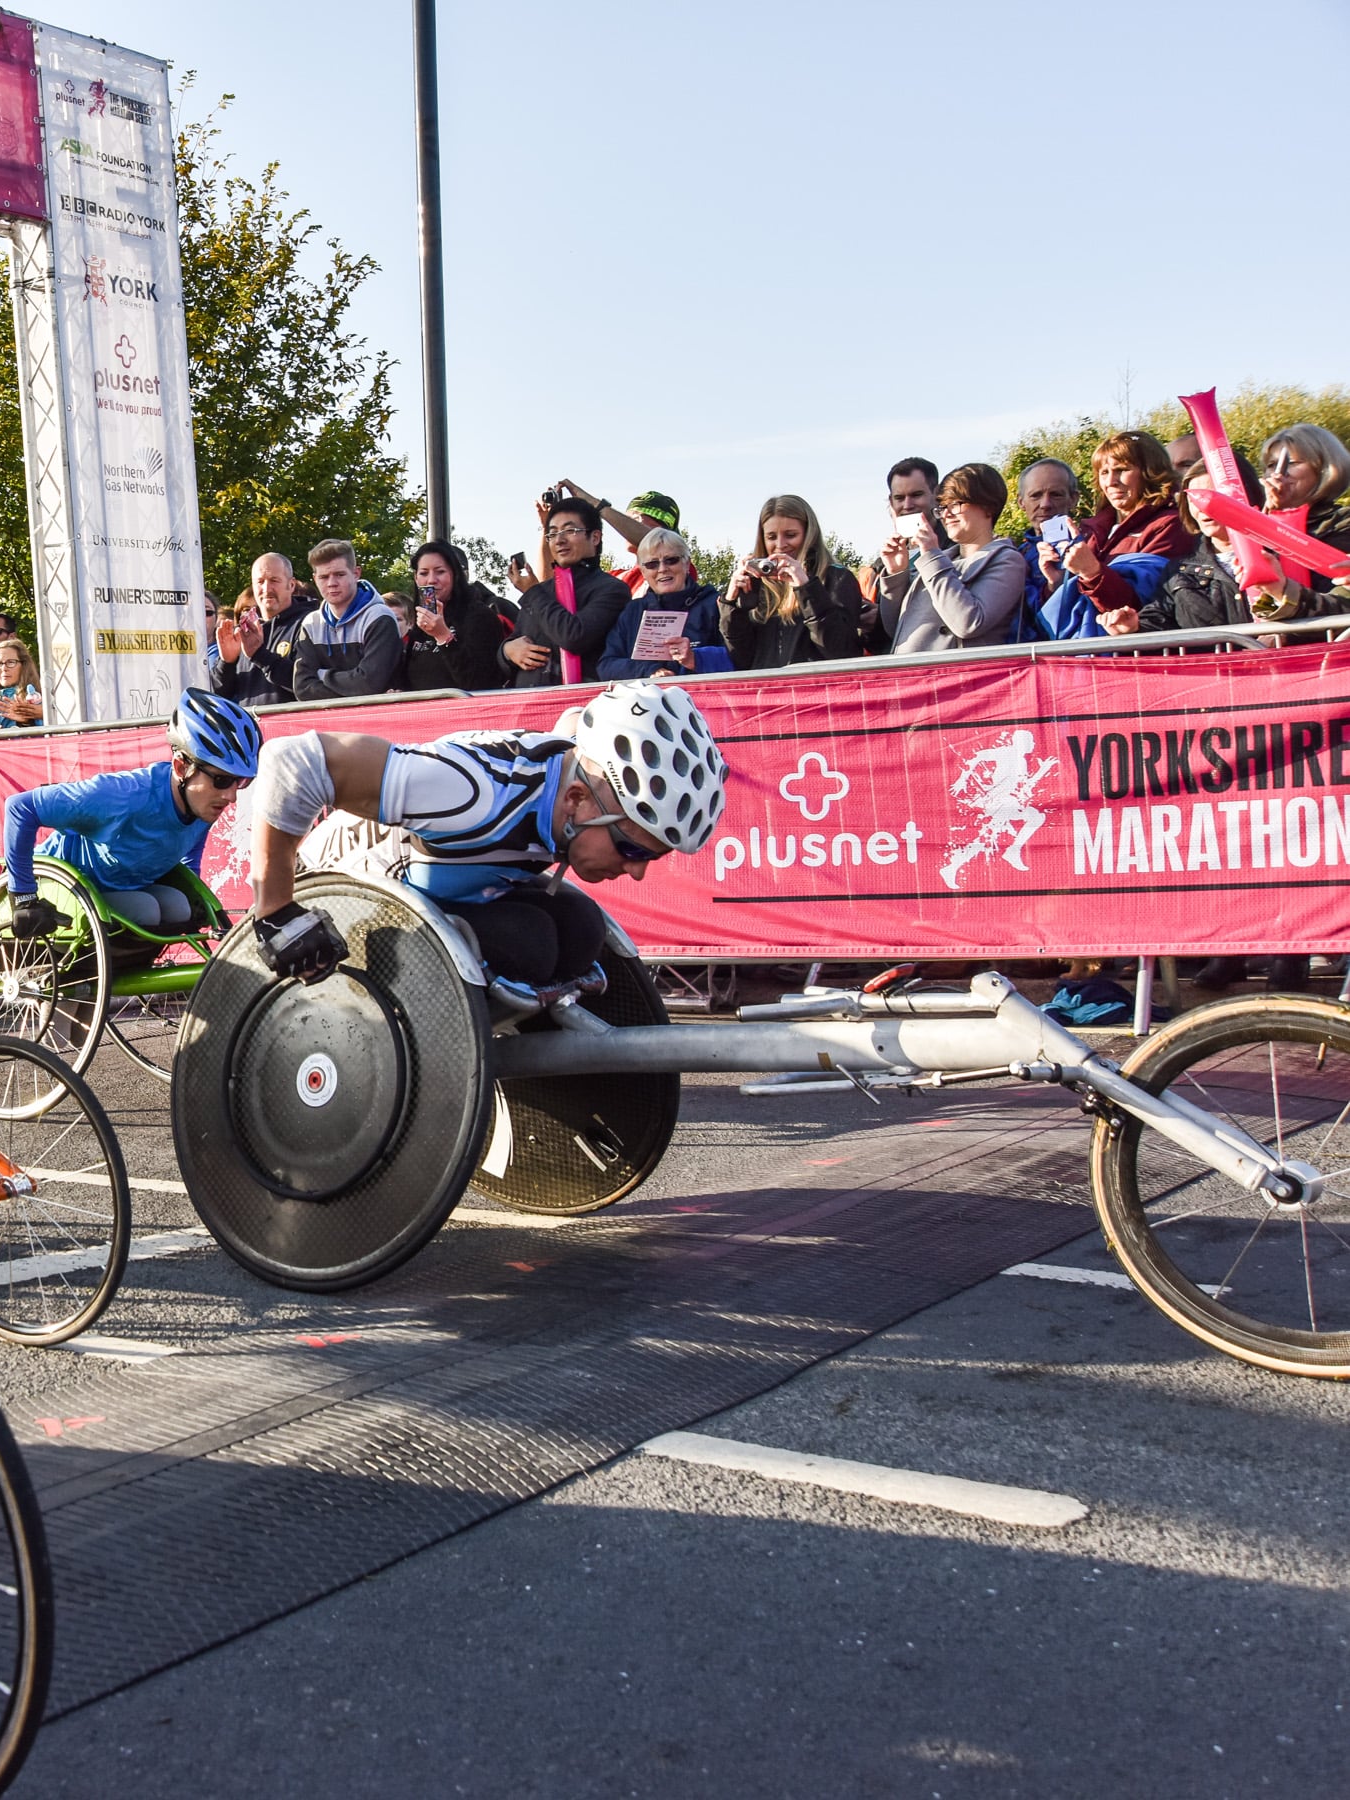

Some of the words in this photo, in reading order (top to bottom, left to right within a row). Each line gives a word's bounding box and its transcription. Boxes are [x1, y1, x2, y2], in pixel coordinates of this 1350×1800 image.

[55, 92, 85, 106] plusnet
[61, 138, 93, 158] ASDA
[97, 152, 151, 174] FOUNDATION
[61, 195, 97, 216] BBC
[99, 206, 135, 224] RADIO
[137, 215, 166, 232] YORK
[107, 273, 159, 302] YORK
[119, 299, 148, 310] COUNCIL
[94, 368, 160, 396] plusnet
[96, 397, 115, 410] We'll
[116, 401, 124, 412] do
[124, 404, 139, 414] you
[141, 406, 161, 416] proud
[104, 464, 145, 479] Northern
[105, 479, 121, 491] Gas
[123, 481, 165, 496] Networks
[93, 535, 150, 549] UNIVERSITY
[151, 538, 162, 551] of
[154, 536, 185, 557] York
[94, 587, 151, 604] RUNNER'S
[154, 591, 188, 604] WORLD
[106, 633, 167, 650] YORKSHIRE
[170, 634, 194, 651] POST
[1067, 718, 1350, 801] YORKSHIRE
[607, 761, 626, 797] catlike
[1073, 795, 1350, 875] MARATHON
[714, 820, 923, 881] plusnet
